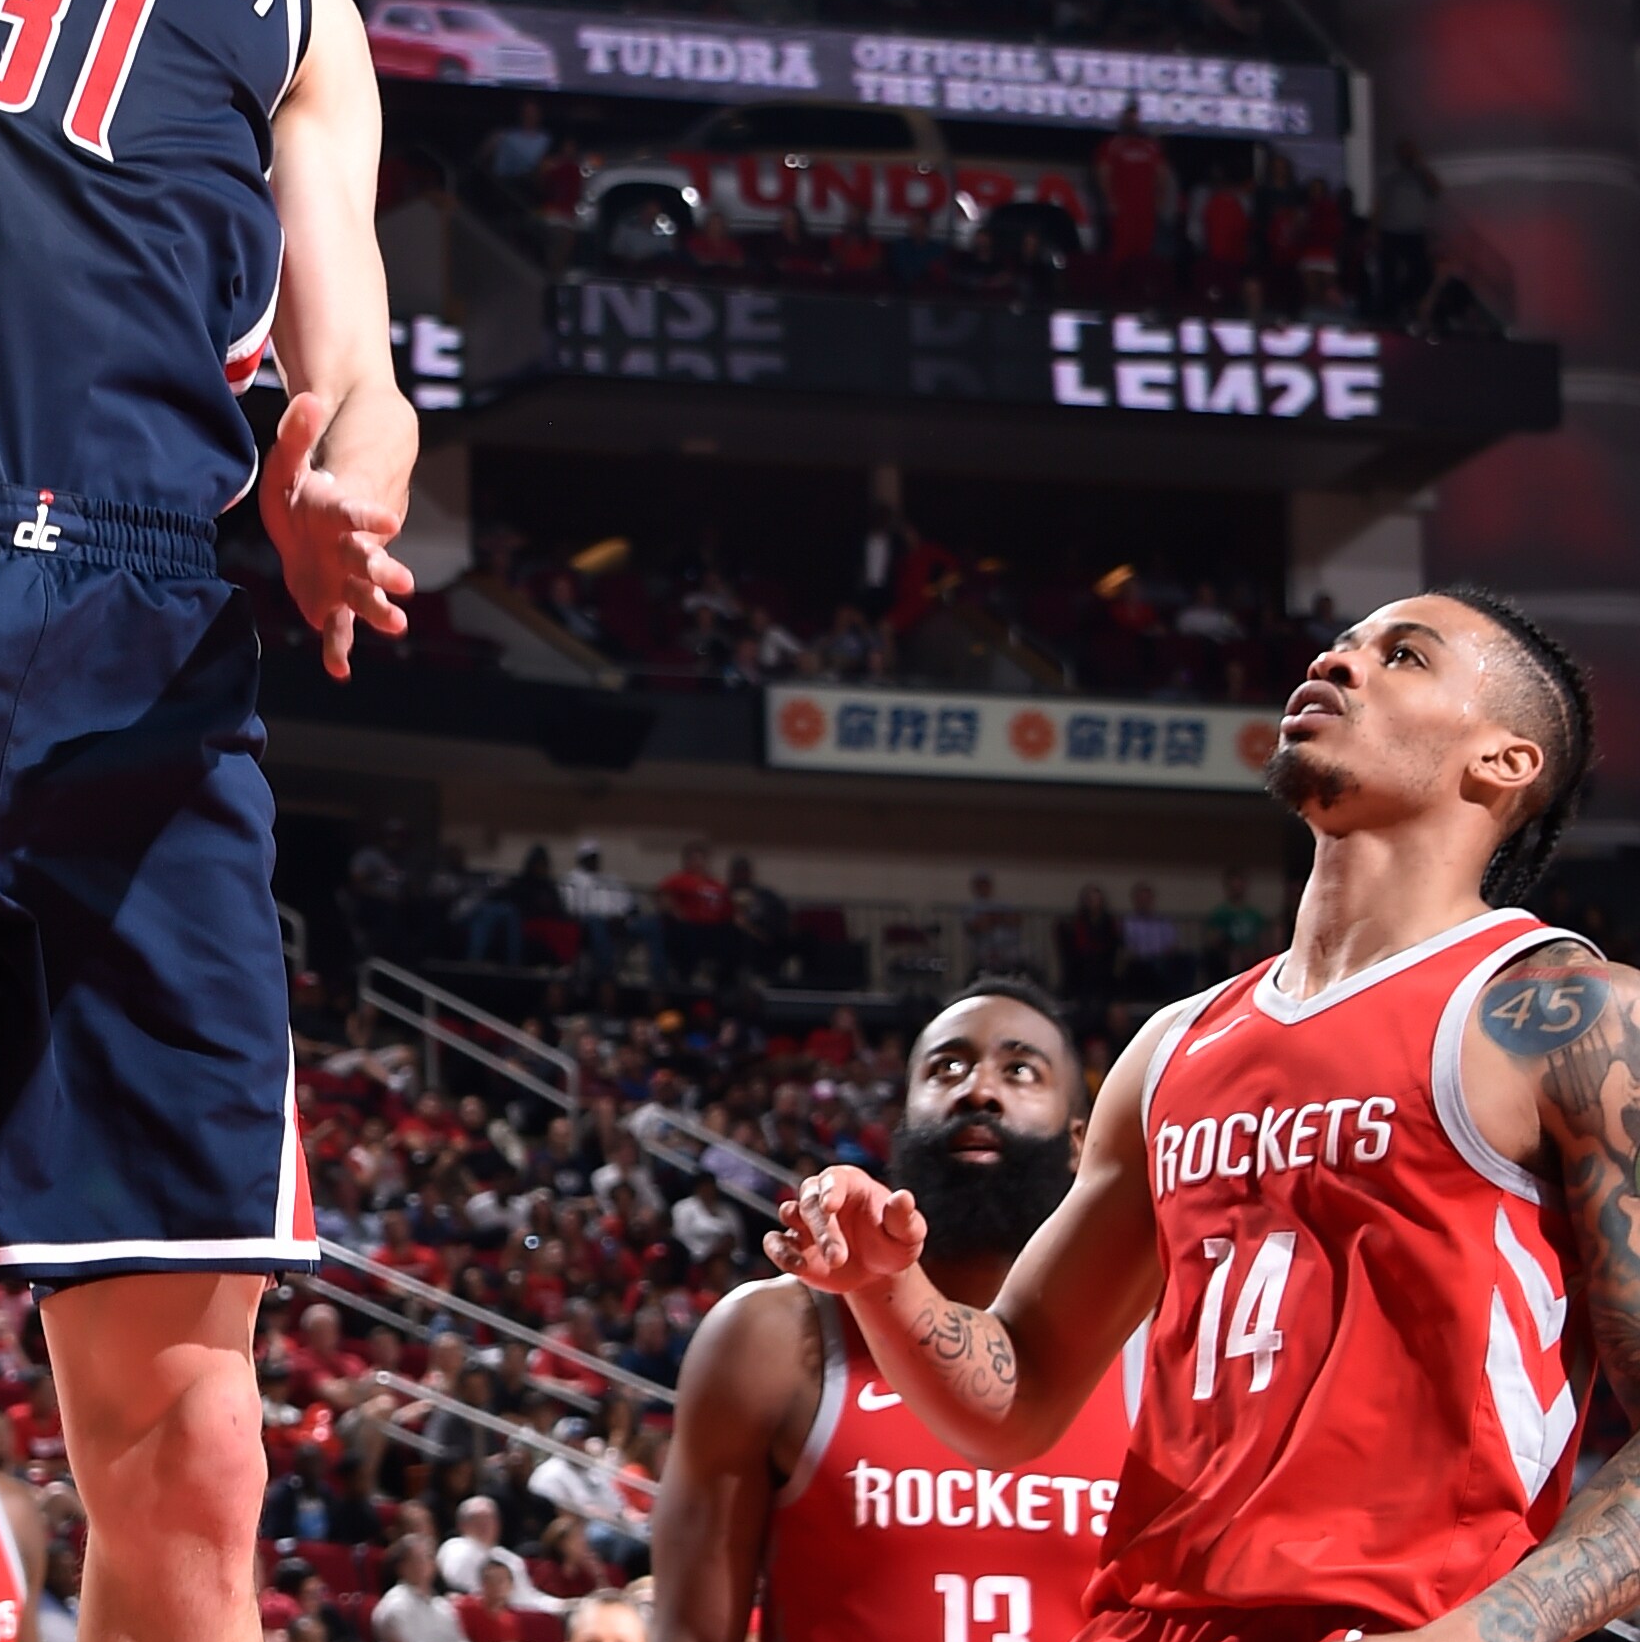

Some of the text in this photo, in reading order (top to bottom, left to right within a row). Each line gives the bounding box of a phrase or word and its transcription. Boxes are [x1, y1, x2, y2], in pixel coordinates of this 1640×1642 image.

[576, 25, 819, 89] TUNDRA
[853, 34, 1280, 101] OFFICIAL VEHICLE OF
[853, 71, 936, 109] THE
[943, 77, 1126, 122] HOUSTON
[670, 147, 1092, 228] TUNDRA
[1489, 985, 1585, 1033] 45
[1154, 1095, 1396, 1199] ROCKETS
[1192, 1231, 1297, 1401] 14
